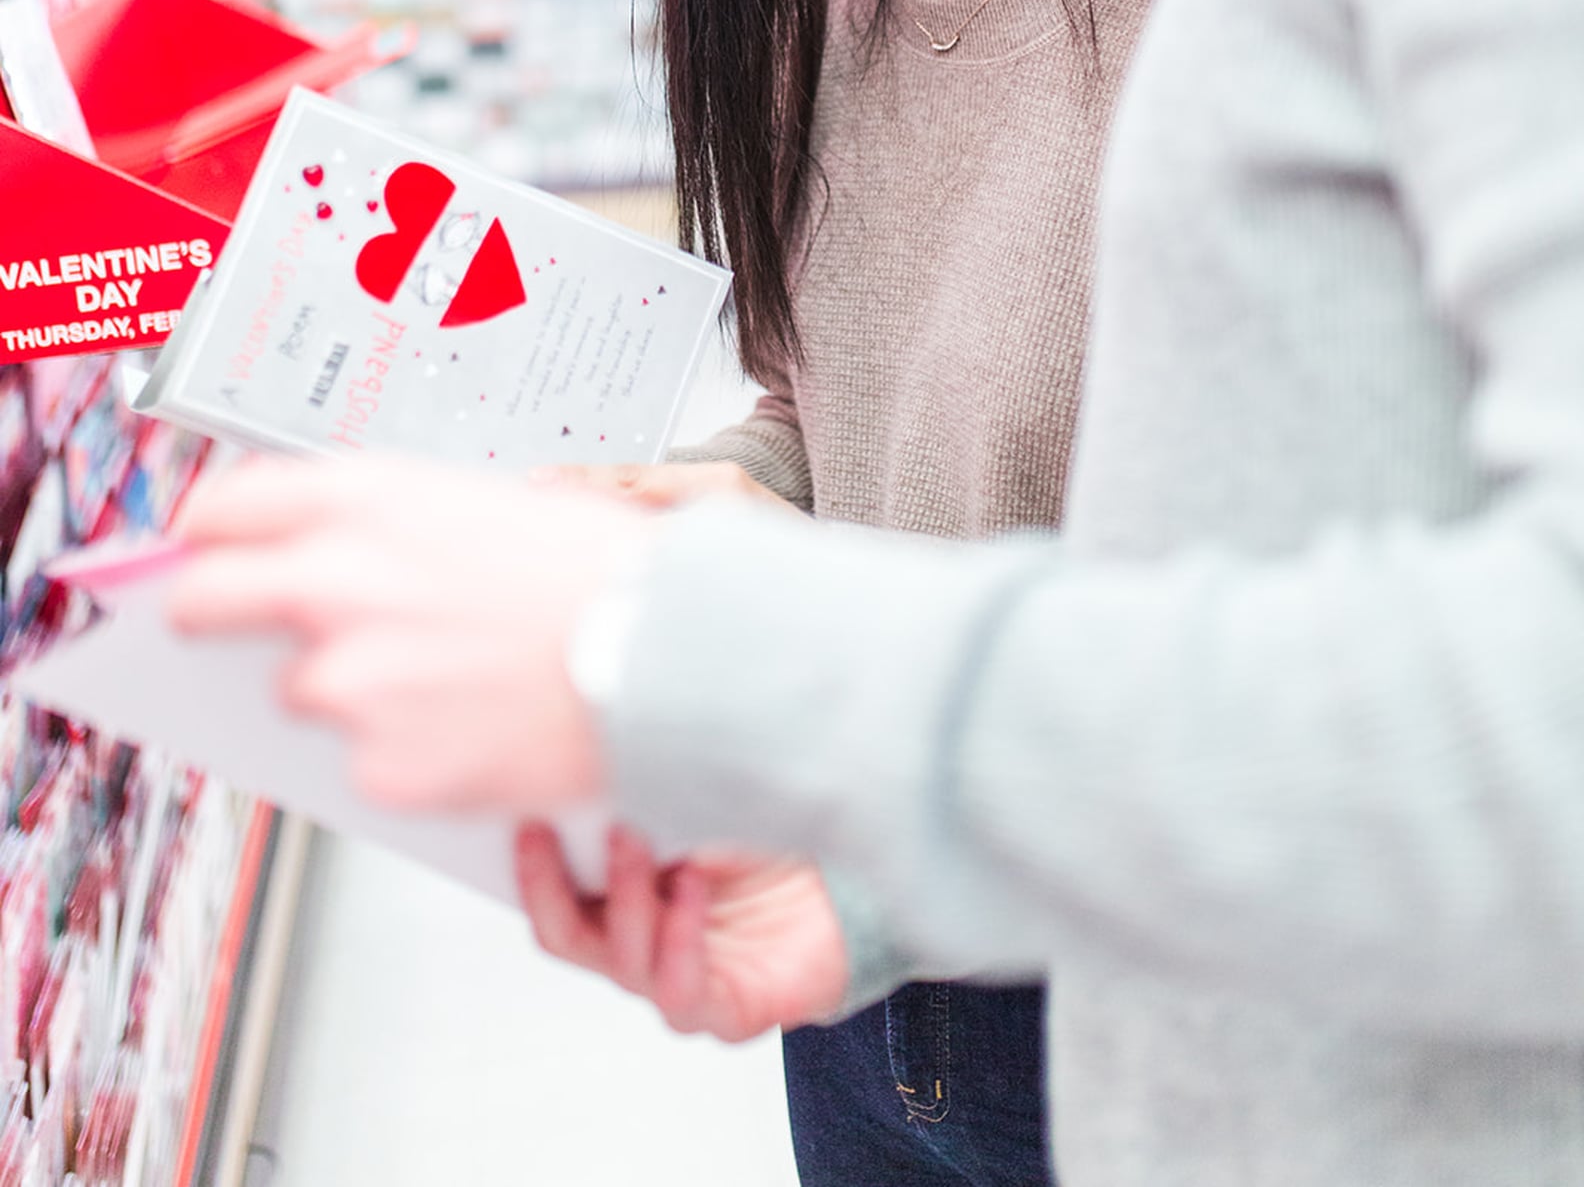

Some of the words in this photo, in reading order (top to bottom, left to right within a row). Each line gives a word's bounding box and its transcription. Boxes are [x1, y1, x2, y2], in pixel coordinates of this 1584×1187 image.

[0, 239, 213, 290] VALENTINE'S
[75, 278, 142, 312] DAY
[1, 315, 136, 351] THURSDAY,
